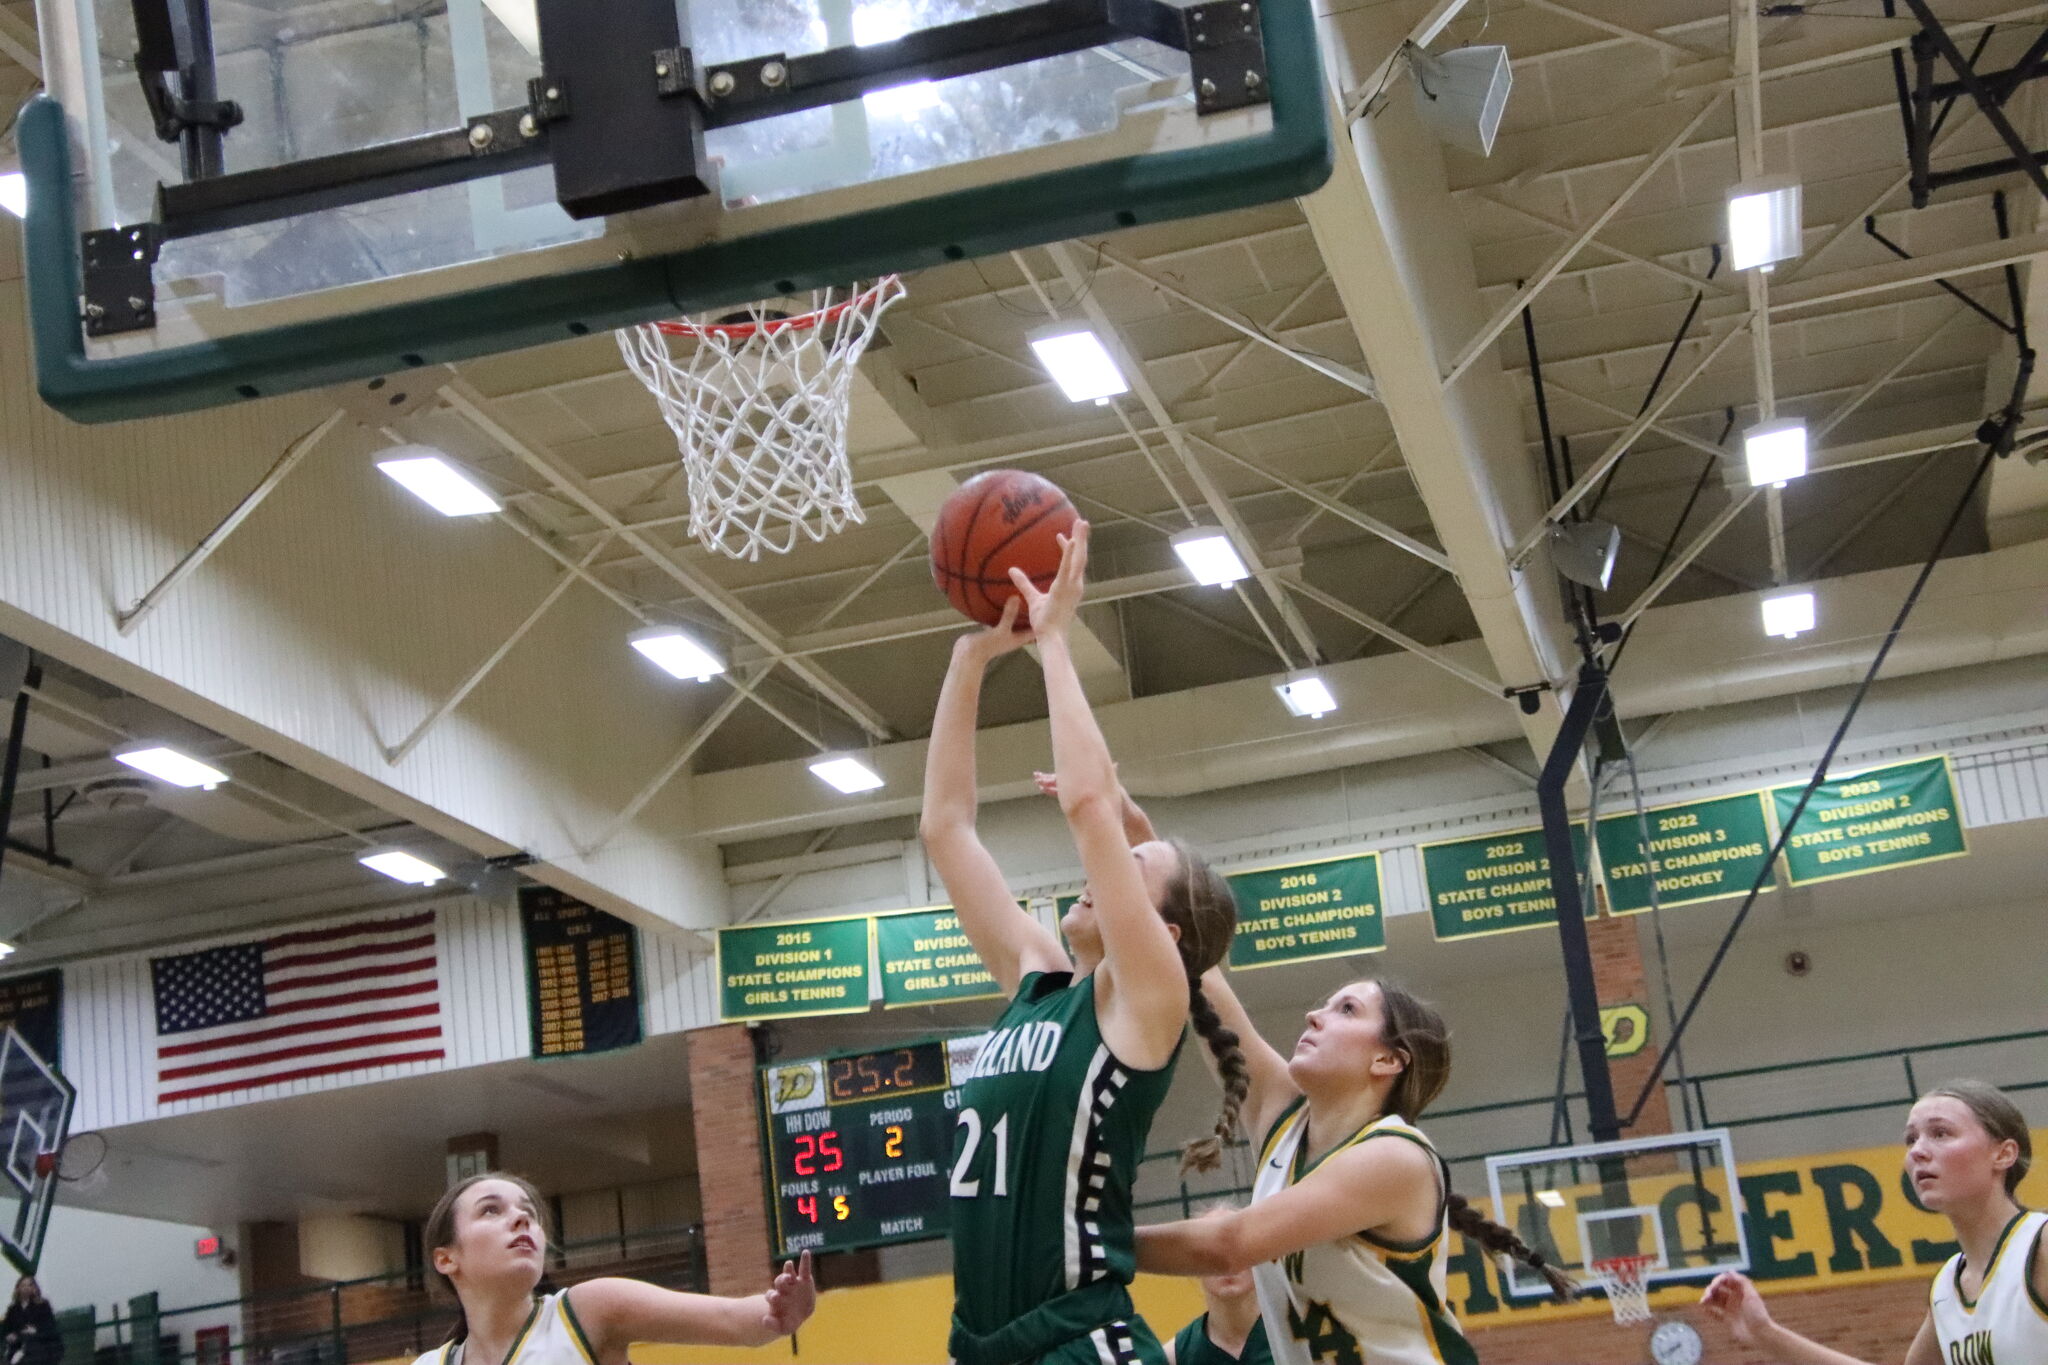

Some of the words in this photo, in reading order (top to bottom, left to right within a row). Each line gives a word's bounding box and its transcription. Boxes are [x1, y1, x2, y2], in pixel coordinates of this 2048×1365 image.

[1840, 781, 1880, 798] 2023
[1819, 796, 1895, 823] DIVISION
[1900, 795, 1910, 808] 2
[1659, 814, 1698, 831] 2022
[1792, 830, 1843, 848] STATE
[1848, 808, 1950, 838] CHAMPIONS
[1715, 829, 1726, 843] 3
[1486, 843, 1523, 858] 2022
[1818, 846, 1863, 864] BOYS
[1869, 832, 1931, 853] TENNIS
[1466, 861, 1537, 882] DIVISION
[1541, 858, 1550, 870] 2
[1611, 861, 1661, 879] STATE
[1664, 843, 1763, 870] CHAMPIONS
[1280, 874, 1317, 889] 2016
[1656, 870, 1723, 892] HOCKEY
[1260, 892, 1328, 911] DIVISION
[1332, 889, 1342, 902] 2
[1438, 888, 1486, 906] STATE
[1235, 917, 1280, 935] STATE
[1283, 903, 1375, 928] CHAMPIONS
[1462, 906, 1504, 922] BOYS
[1508, 897, 1557, 917] TENNI
[934, 916, 960, 931] 201
[776, 932, 811, 946] 2015
[914, 935, 972, 952] DIVISIO
[1255, 935, 1296, 952] BOYS
[1298, 926, 1357, 945] TENNIS
[755, 949, 820, 966] DIVISION
[824, 949, 832, 961] 1
[886, 959, 931, 974] STATE
[727, 971, 771, 988] STATE
[775, 964, 862, 984] CHAMPIONS
[904, 975, 948, 991] GIRLS
[745, 989, 788, 1004] GIRLS
[791, 985, 846, 1001] TENNIS
[834, 1049, 913, 1097] 25.2
[804, 1110, 831, 1131] DOW
[869, 1108, 913, 1126] PERIOD
[885, 1125, 903, 1158] 2
[950, 1107, 1007, 1197] 21
[795, 1131, 843, 1176] 25
[859, 1166, 904, 1185] PLAYER
[906, 1162, 938, 1180] FOUL
[780, 1180, 820, 1197] FOULS
[797, 1195, 818, 1224] 4
[833, 1195, 850, 1221] 5
[880, 1217, 924, 1236] MATCH
[786, 1232, 824, 1251] SCORE
